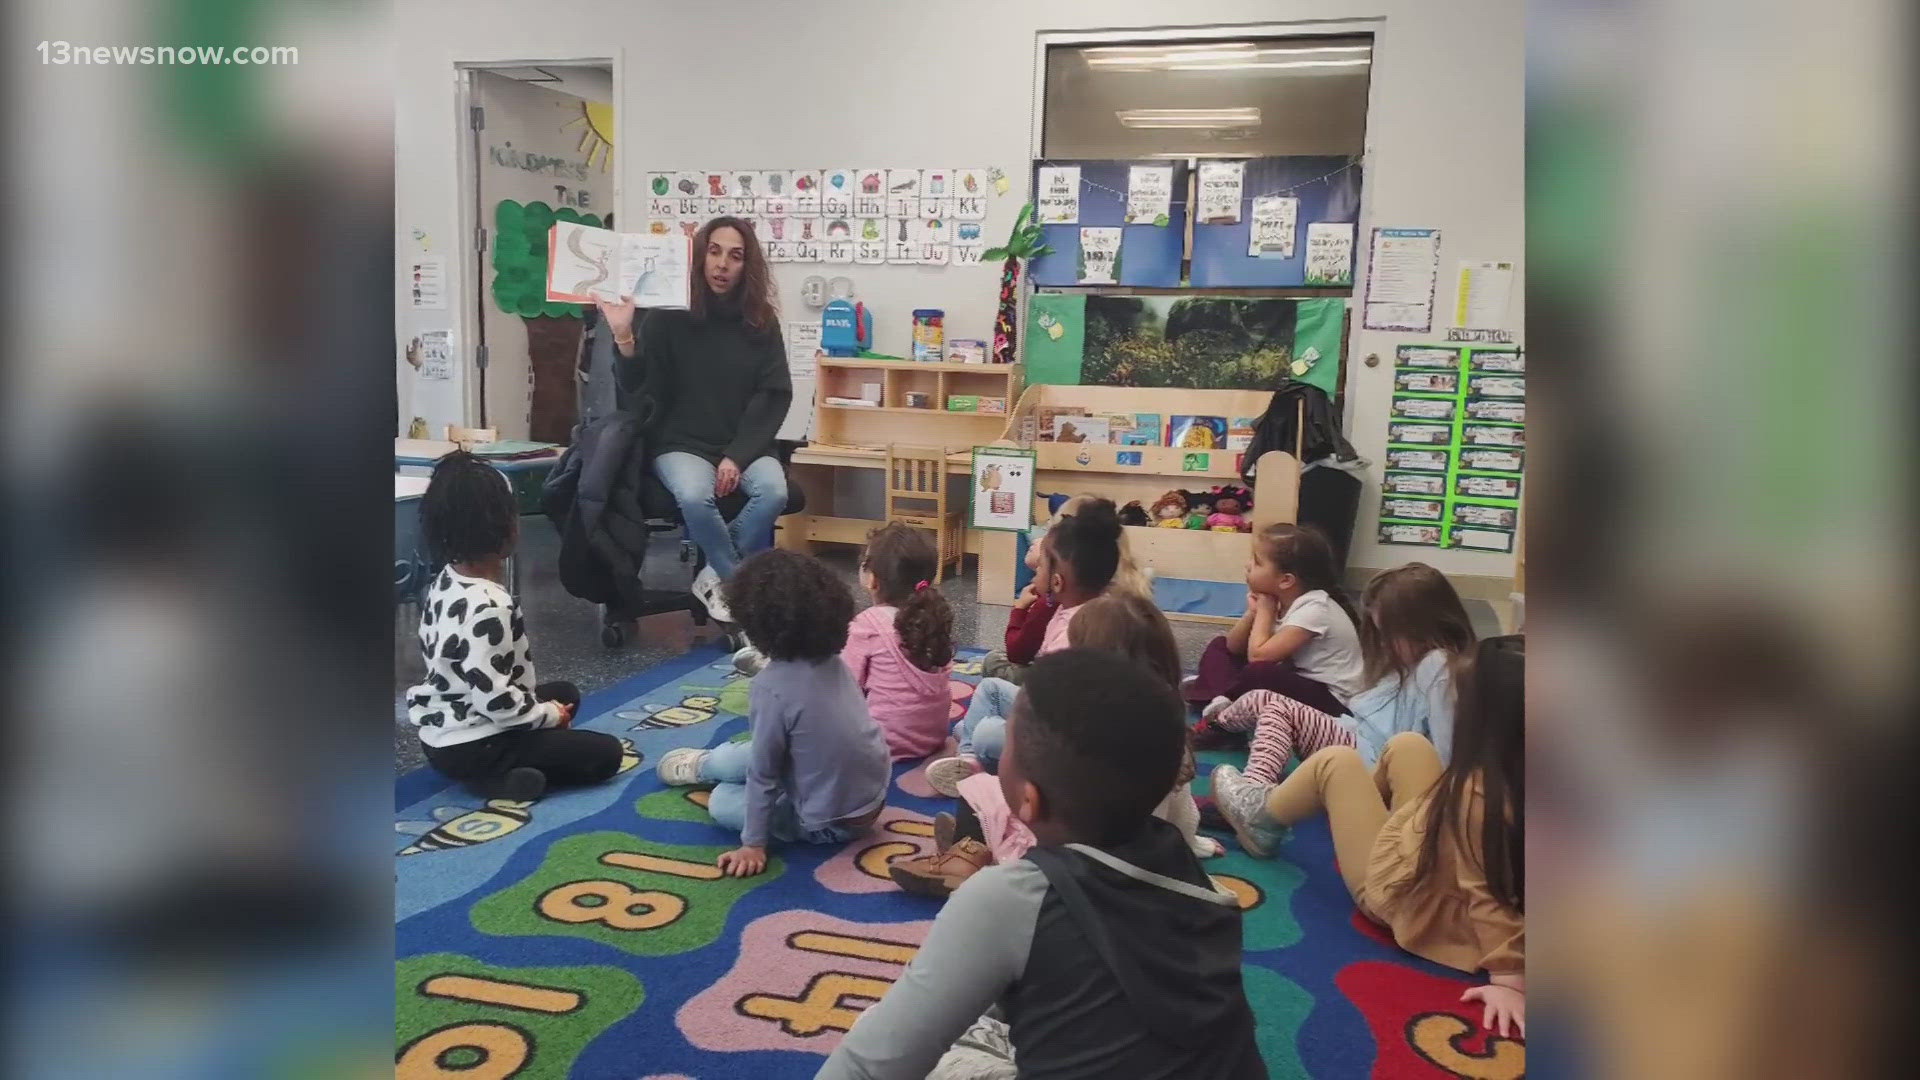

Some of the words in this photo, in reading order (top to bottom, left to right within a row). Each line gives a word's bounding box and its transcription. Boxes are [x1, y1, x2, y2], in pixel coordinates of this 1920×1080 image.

[651, 199, 671, 214] Aa
[680, 199, 698, 214] Bb
[708, 198, 726, 214] Cc
[766, 199, 784, 214] Ee
[827, 197, 847, 218] Gg
[860, 198, 879, 214] Hh
[928, 198, 944, 217] Jj
[960, 197, 979, 214] Kk
[796, 241, 817, 259] Qq
[830, 243, 844, 258] Rr
[860, 242, 879, 258] Ss
[896, 243, 909, 259] Tt
[923, 244, 942, 260] Uu
[960, 246, 977, 262] Vv
[533, 849, 728, 931] 18
